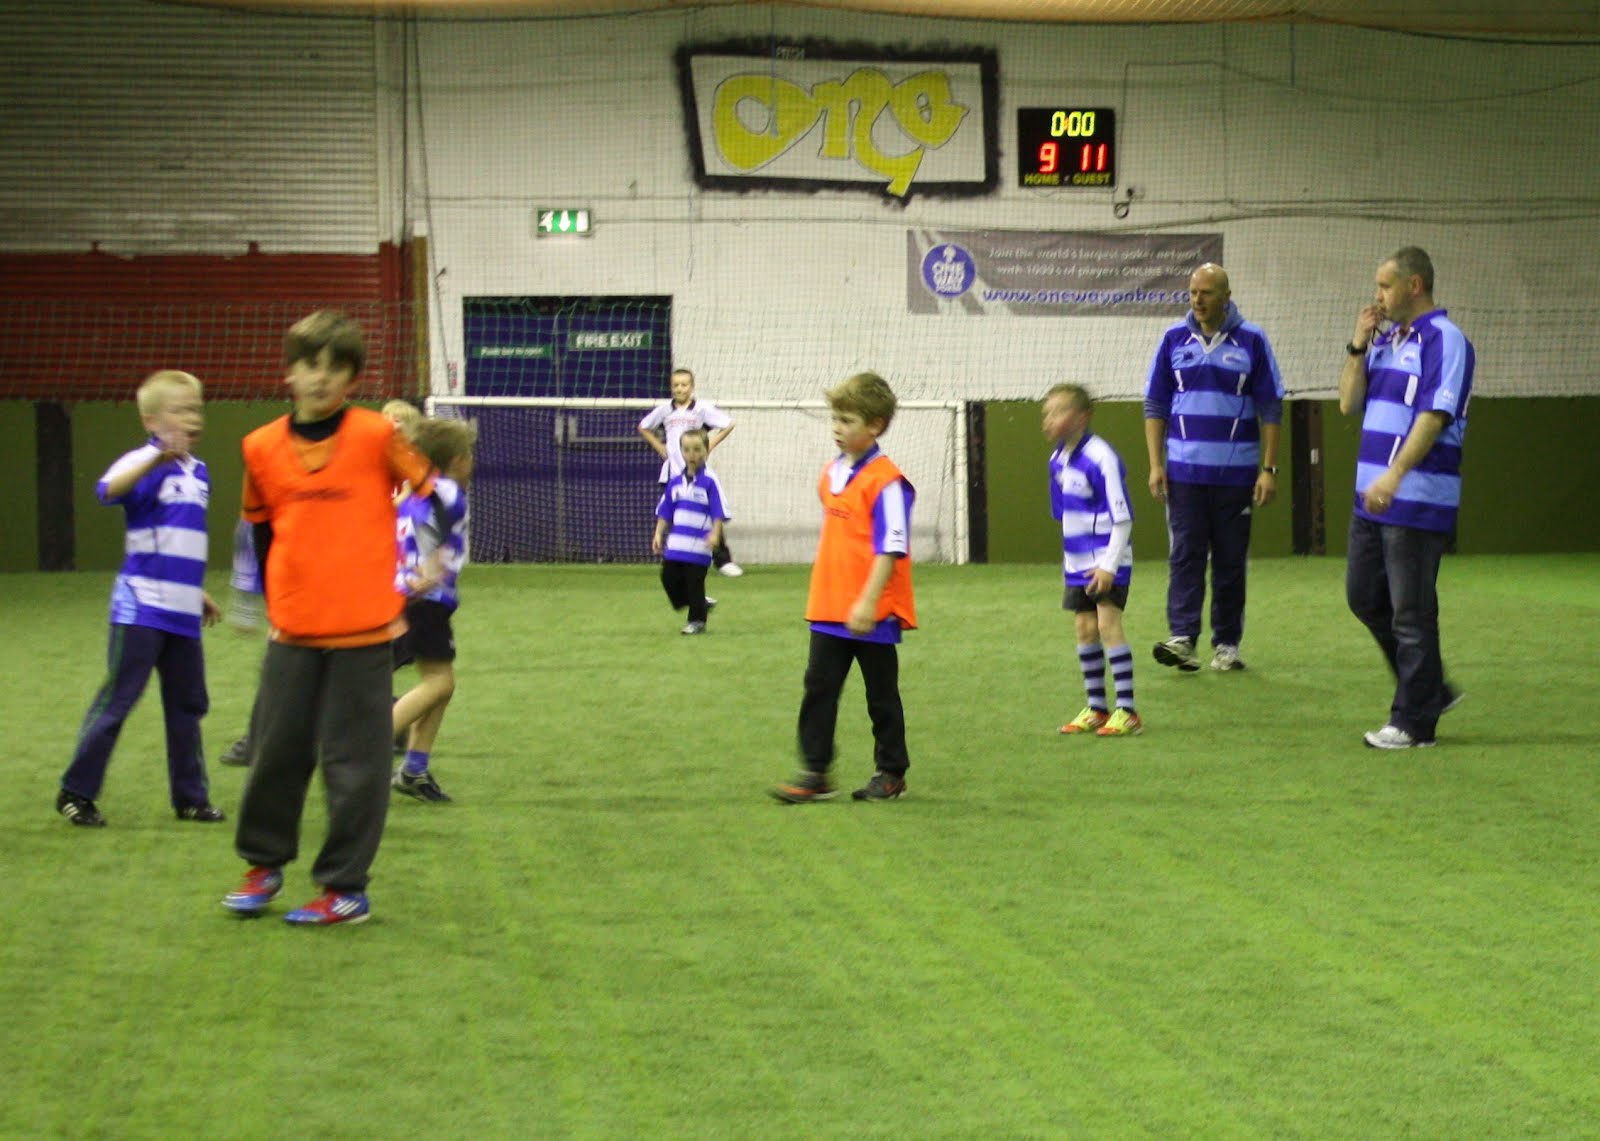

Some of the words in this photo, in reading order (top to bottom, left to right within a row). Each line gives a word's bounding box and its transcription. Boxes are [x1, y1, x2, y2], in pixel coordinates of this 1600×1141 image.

[1038, 141, 1059, 173] 9
[1081, 143, 1107, 172] 11
[1024, 173, 1060, 185] HOME
[1073, 173, 1111, 185] GUEST
[576, 332, 608, 349] FIRE
[610, 331, 645, 348] EXIT
